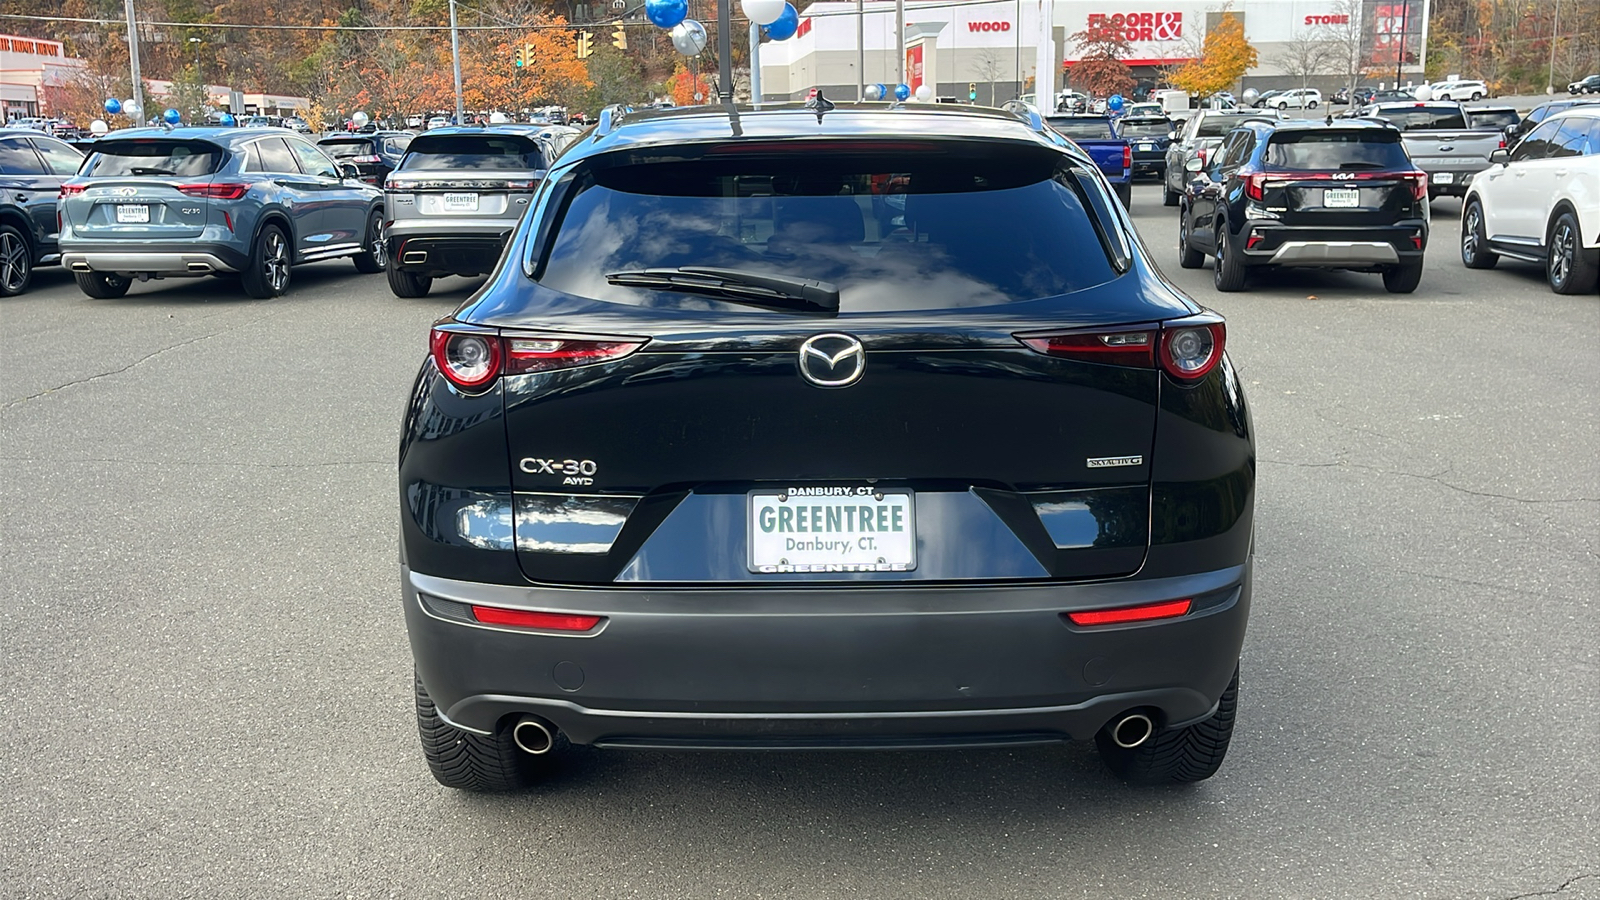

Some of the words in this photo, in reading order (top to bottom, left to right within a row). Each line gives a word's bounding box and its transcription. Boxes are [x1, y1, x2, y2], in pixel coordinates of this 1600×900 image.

[1304, 15, 1349, 25] STONE
[967, 21, 1011, 33] WOOD
[0, 37, 10, 51] HE
[11, 39, 35, 54] HOME
[35, 42, 59, 57] DEPOT
[445, 195, 477, 203] GREENTREE
[519, 457, 598, 476] CX-30
[562, 476, 594, 486] AWD
[787, 486, 853, 497] DANBURY,
[856, 486, 875, 496] CT
[759, 505, 904, 534] GREENTREE
[785, 536, 853, 555] Danbury,
[858, 537, 878, 551] CT.
[758, 563, 907, 574] GREENTREE
